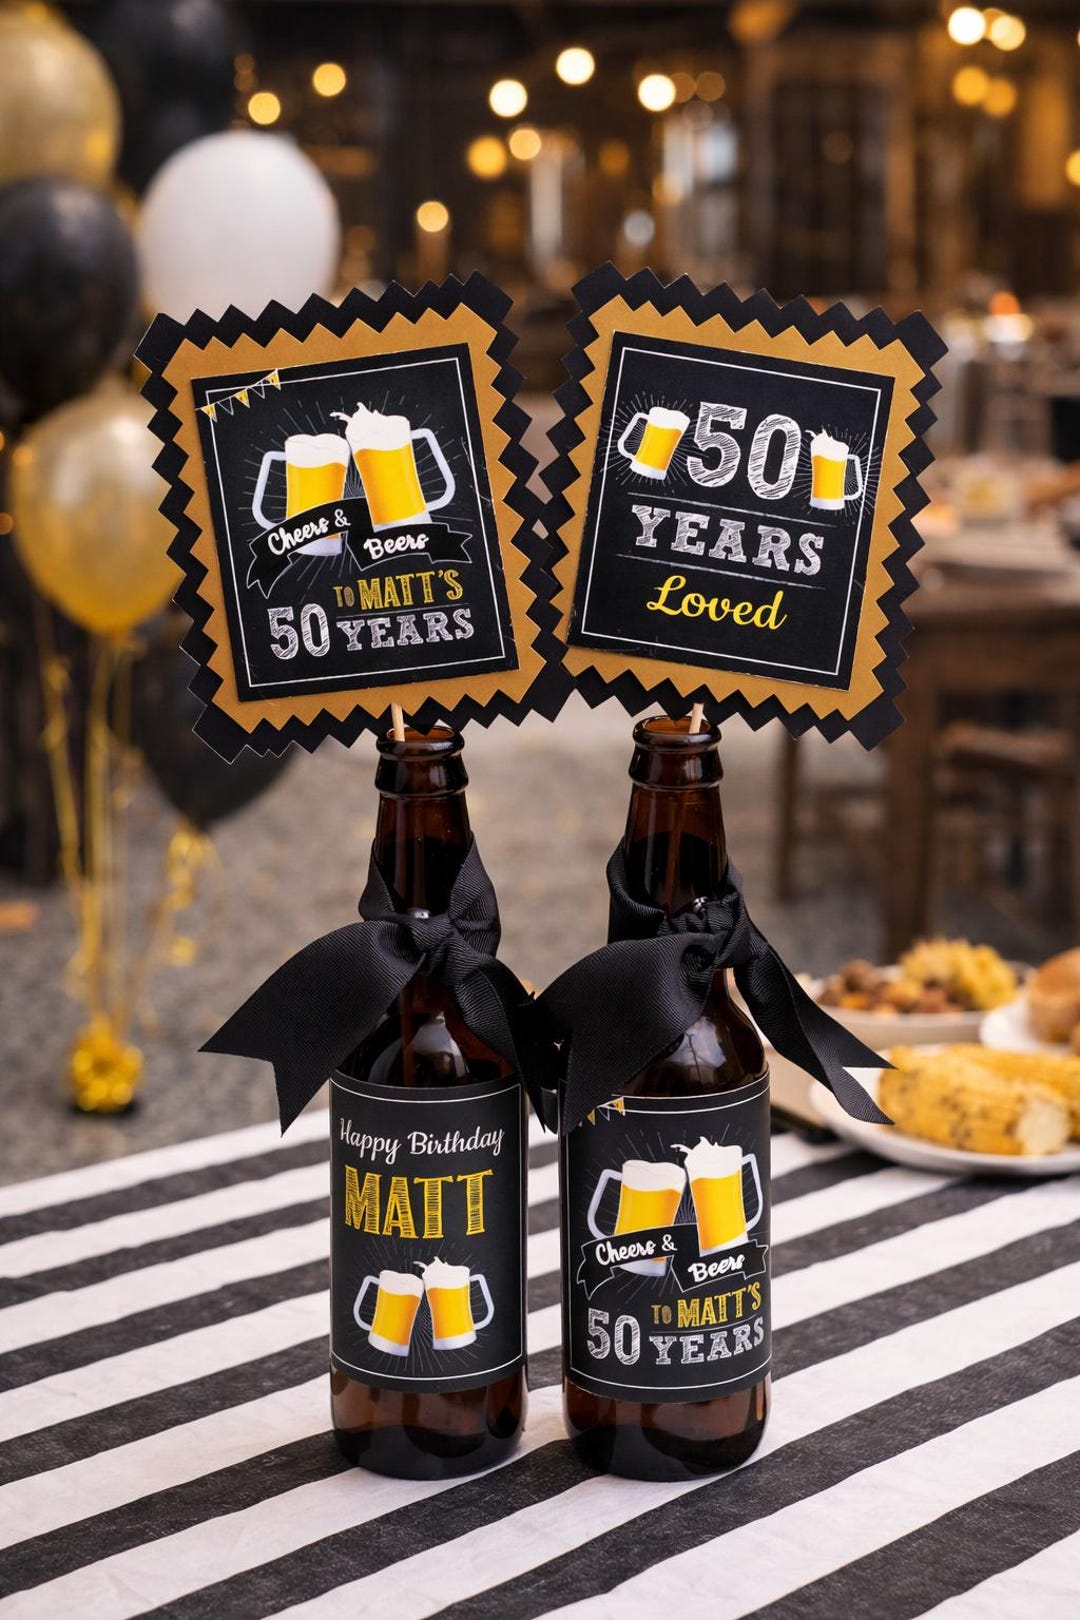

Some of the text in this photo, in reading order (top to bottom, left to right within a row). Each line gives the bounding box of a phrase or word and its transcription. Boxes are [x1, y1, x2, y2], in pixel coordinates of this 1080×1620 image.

[687, 401, 801, 500] 50
[268, 508, 429, 560] Cheers & Beers
[632, 504, 824, 576] YEARS
[333, 586, 355, 608] TO
[646, 575, 788, 630] Loved
[267, 603, 475, 660] 50 YEARS
[340, 1117, 505, 1165] Happy Birthday
[345, 1164, 494, 1239] MATT
[595, 1233, 746, 1282] Cheers & Beers
[587, 1307, 764, 1366] 50 YEARS
[651, 1304, 672, 1325] TO
